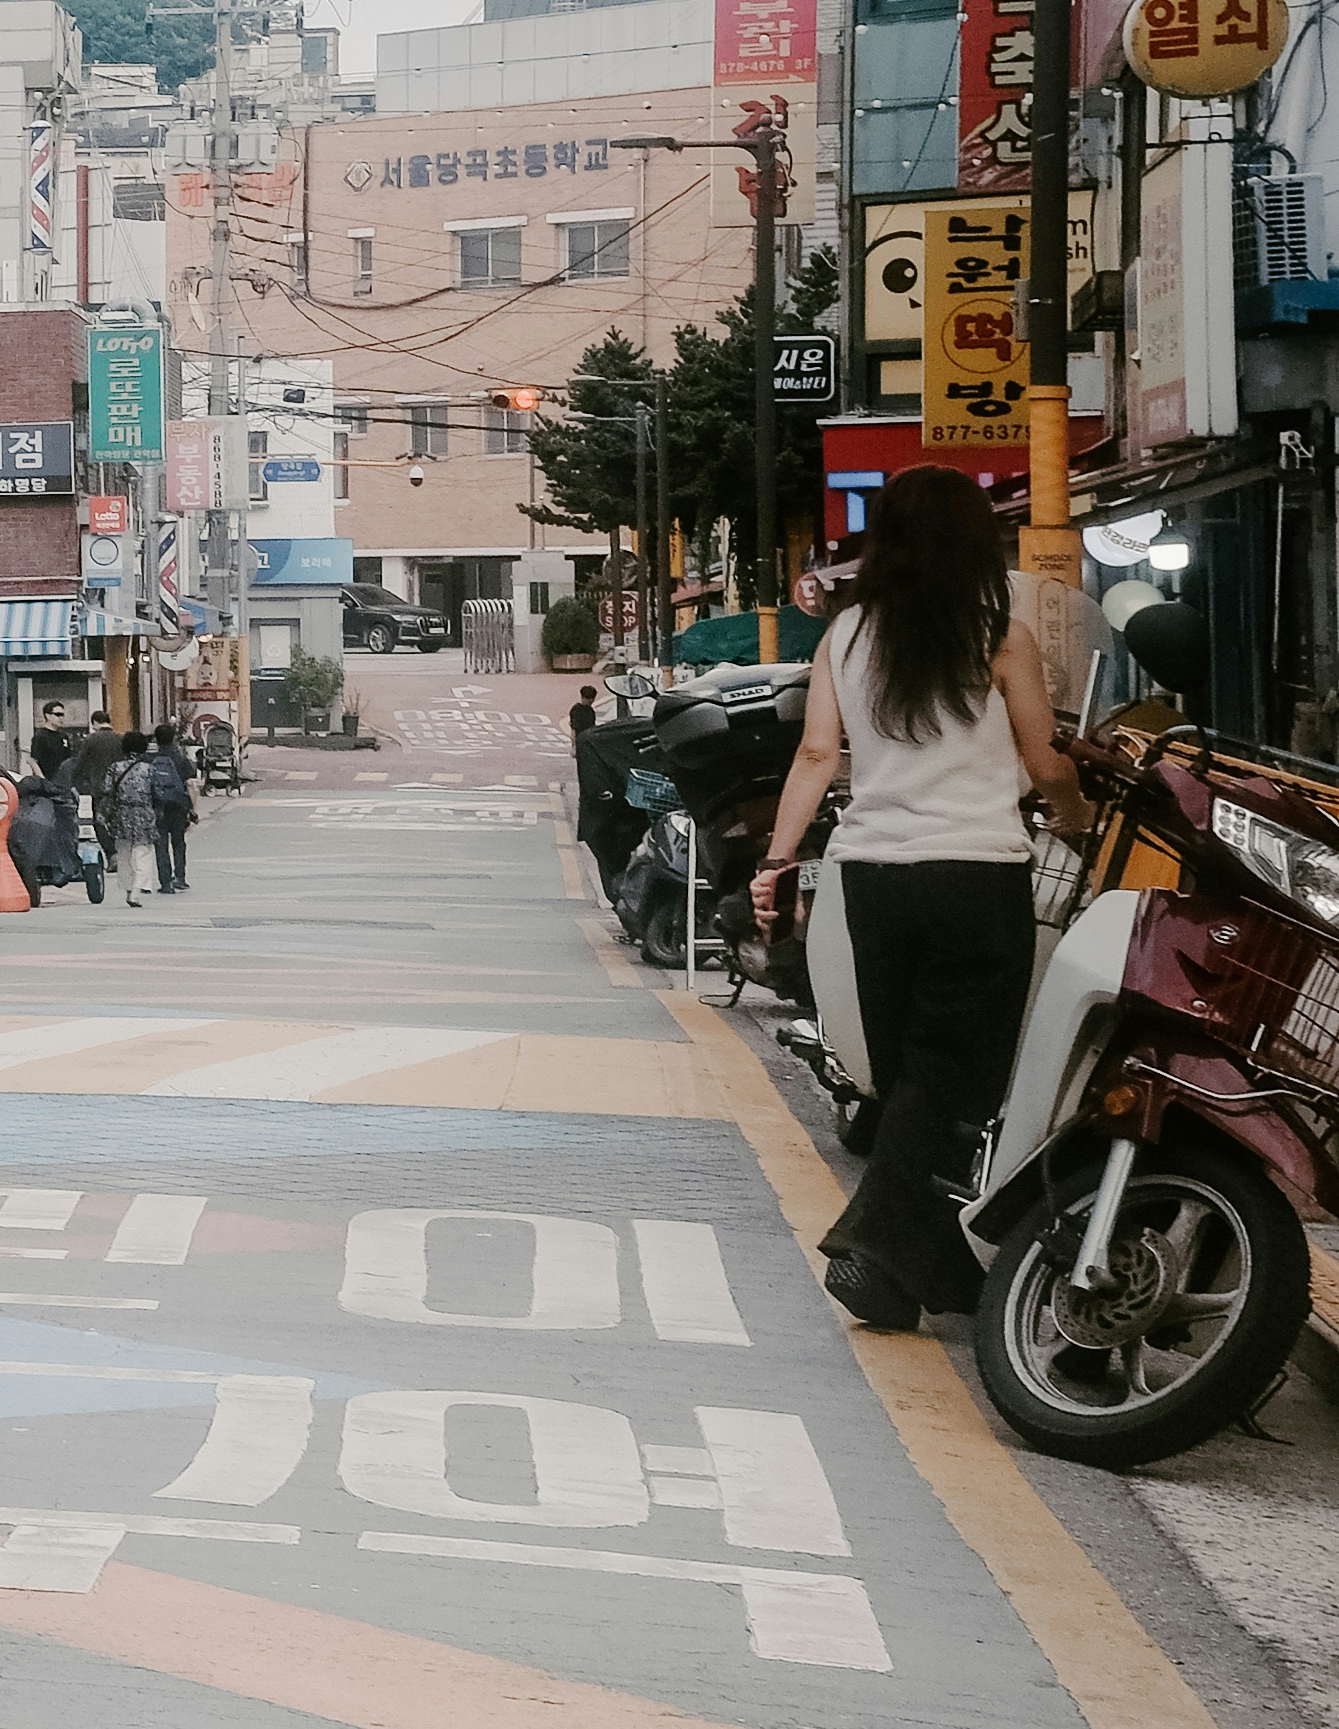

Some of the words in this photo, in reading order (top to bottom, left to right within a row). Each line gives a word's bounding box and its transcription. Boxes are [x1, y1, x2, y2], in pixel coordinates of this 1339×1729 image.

[379, 137, 611, 189] 서울당곡초등학교
[96, 335, 155, 355] LOTTO
[773, 348, 825, 372] 시온
[107, 358, 145, 447] 로또판매
[168, 421, 210, 443] 부자
[175, 443, 205, 507] 부동산
